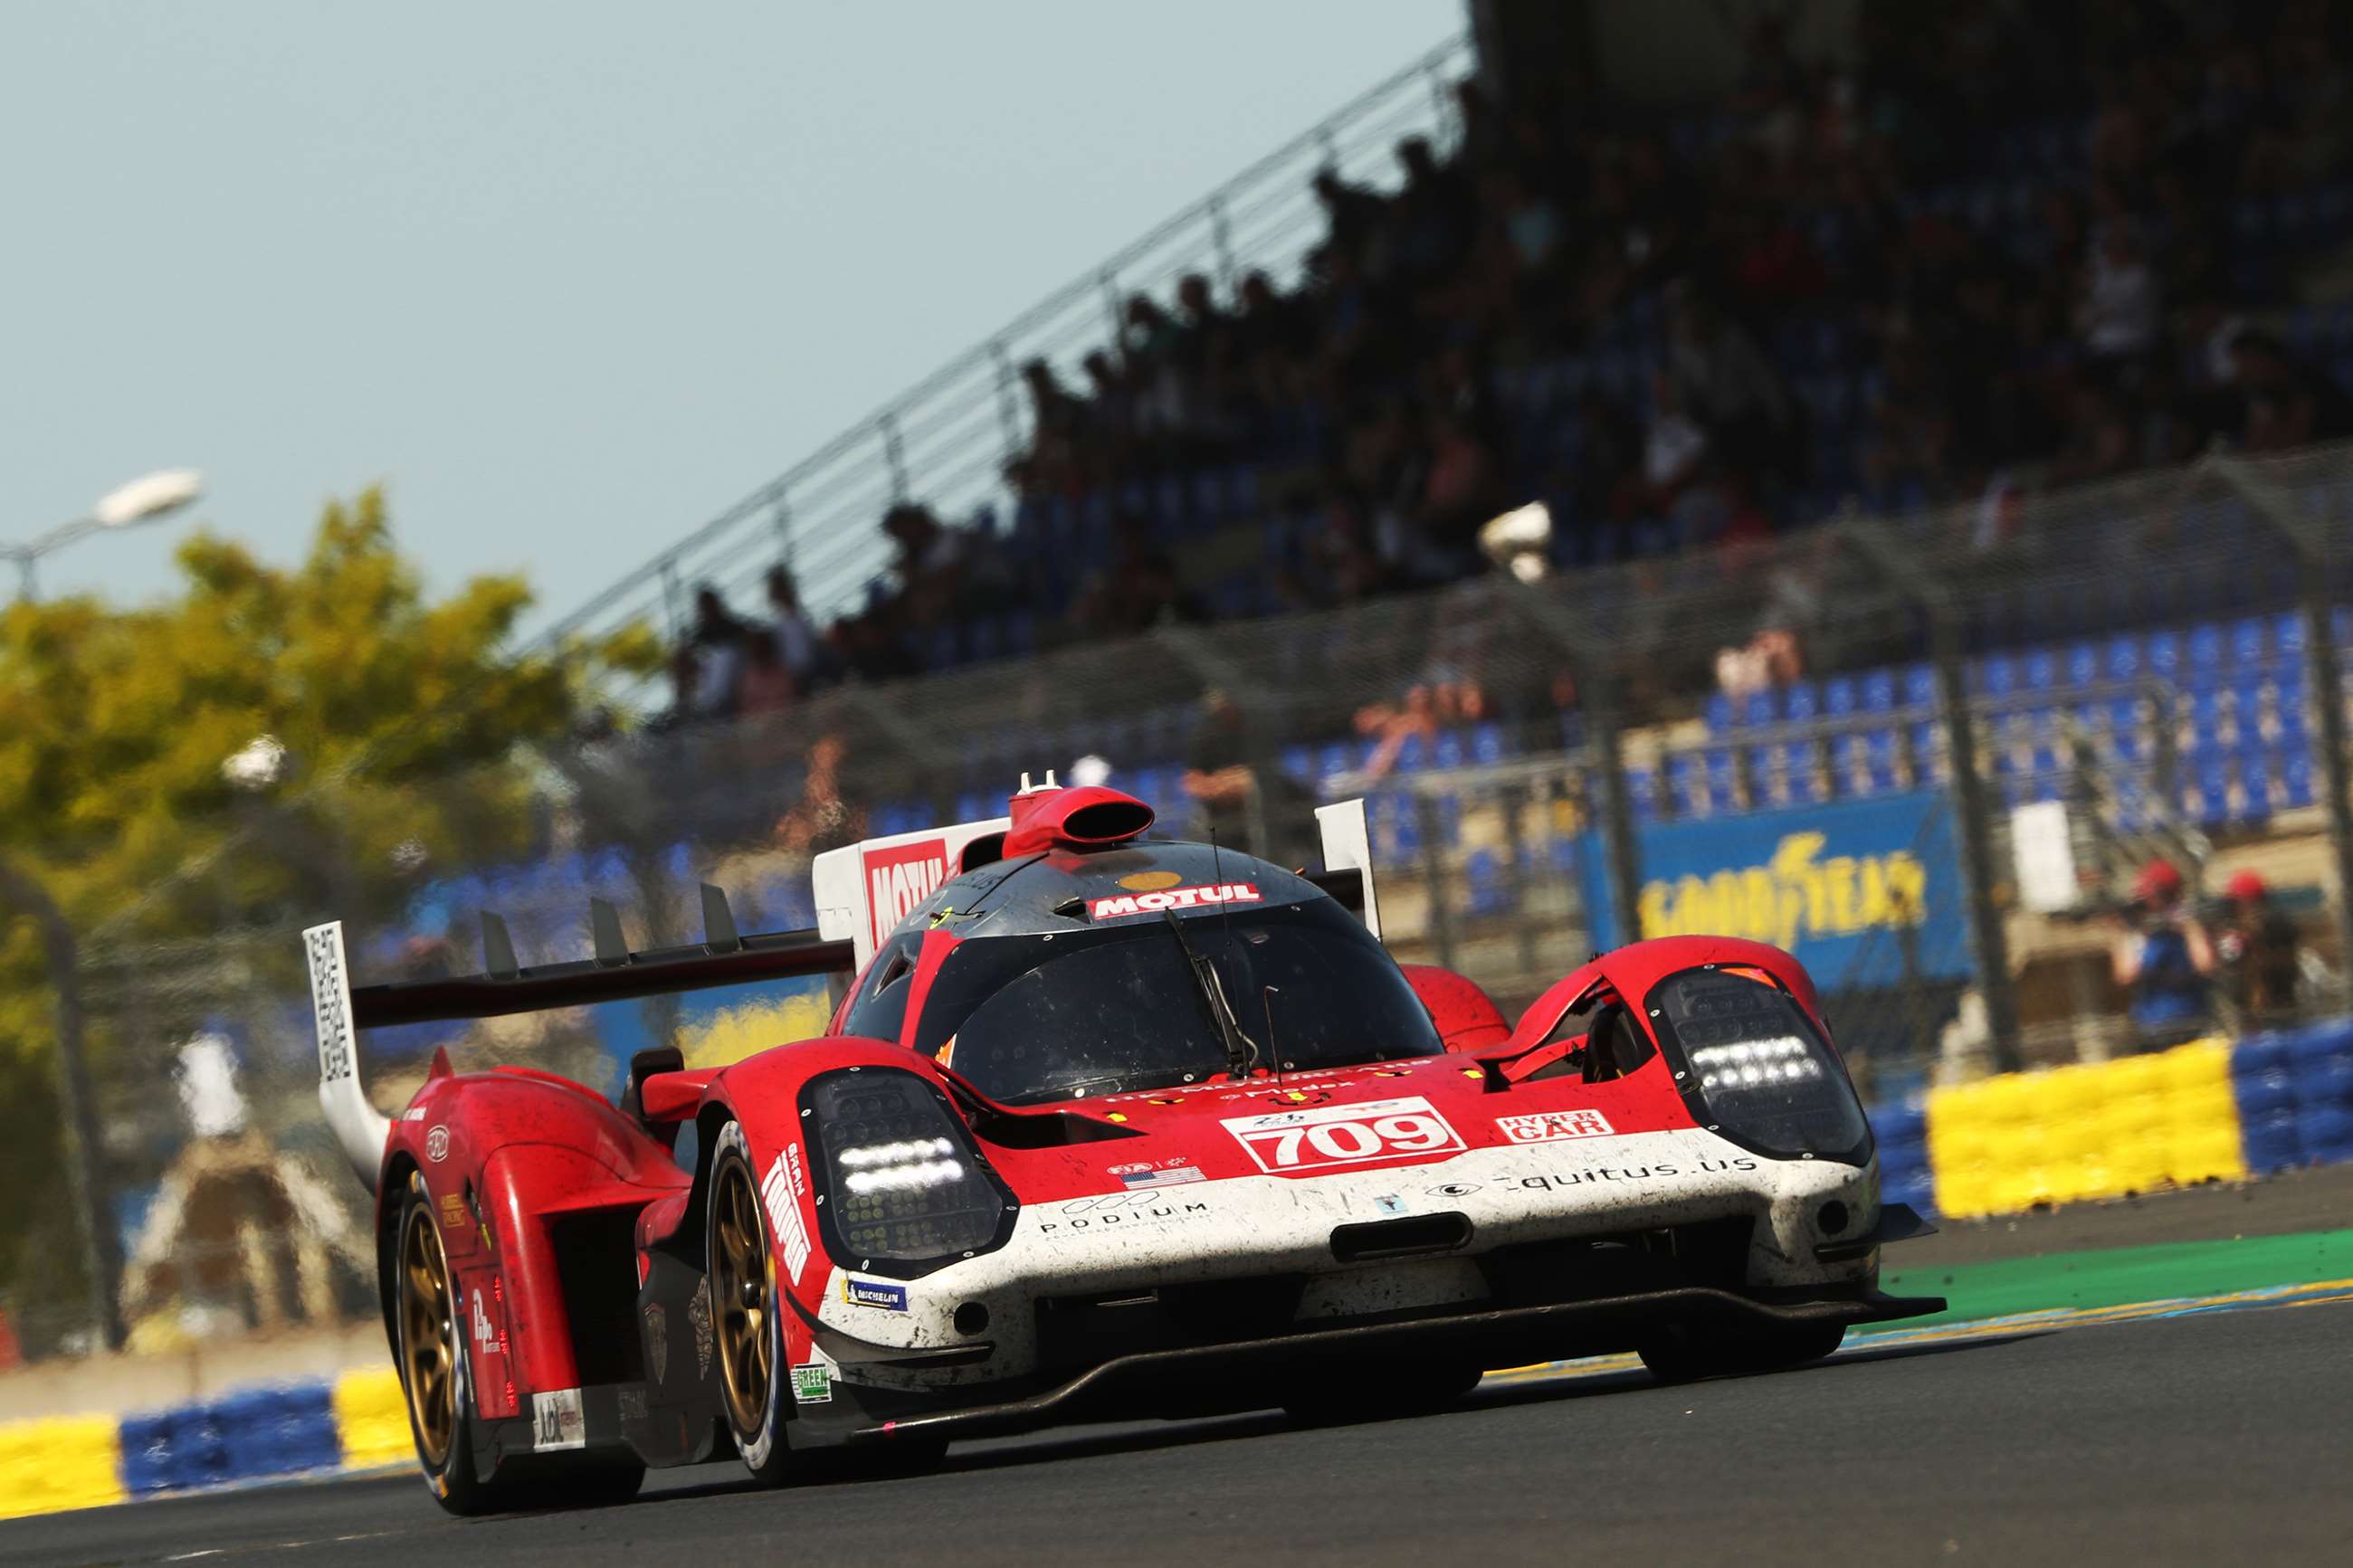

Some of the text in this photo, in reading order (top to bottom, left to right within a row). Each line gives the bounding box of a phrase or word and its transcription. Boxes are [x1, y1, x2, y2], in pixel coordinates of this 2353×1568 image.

[872, 858, 943, 947] MOT
[1094, 884, 1260, 917] MOTUL
[1502, 1112, 1596, 1127] HYPER
[1510, 1120, 1607, 1140] CAR
[1242, 1114, 1449, 1166] 709
[787, 1142, 805, 1196] GRAN
[1040, 1202, 1207, 1233] PODIUM
[857, 1288, 899, 1304] MICHELIN
[796, 1368, 827, 1387] GREEN
